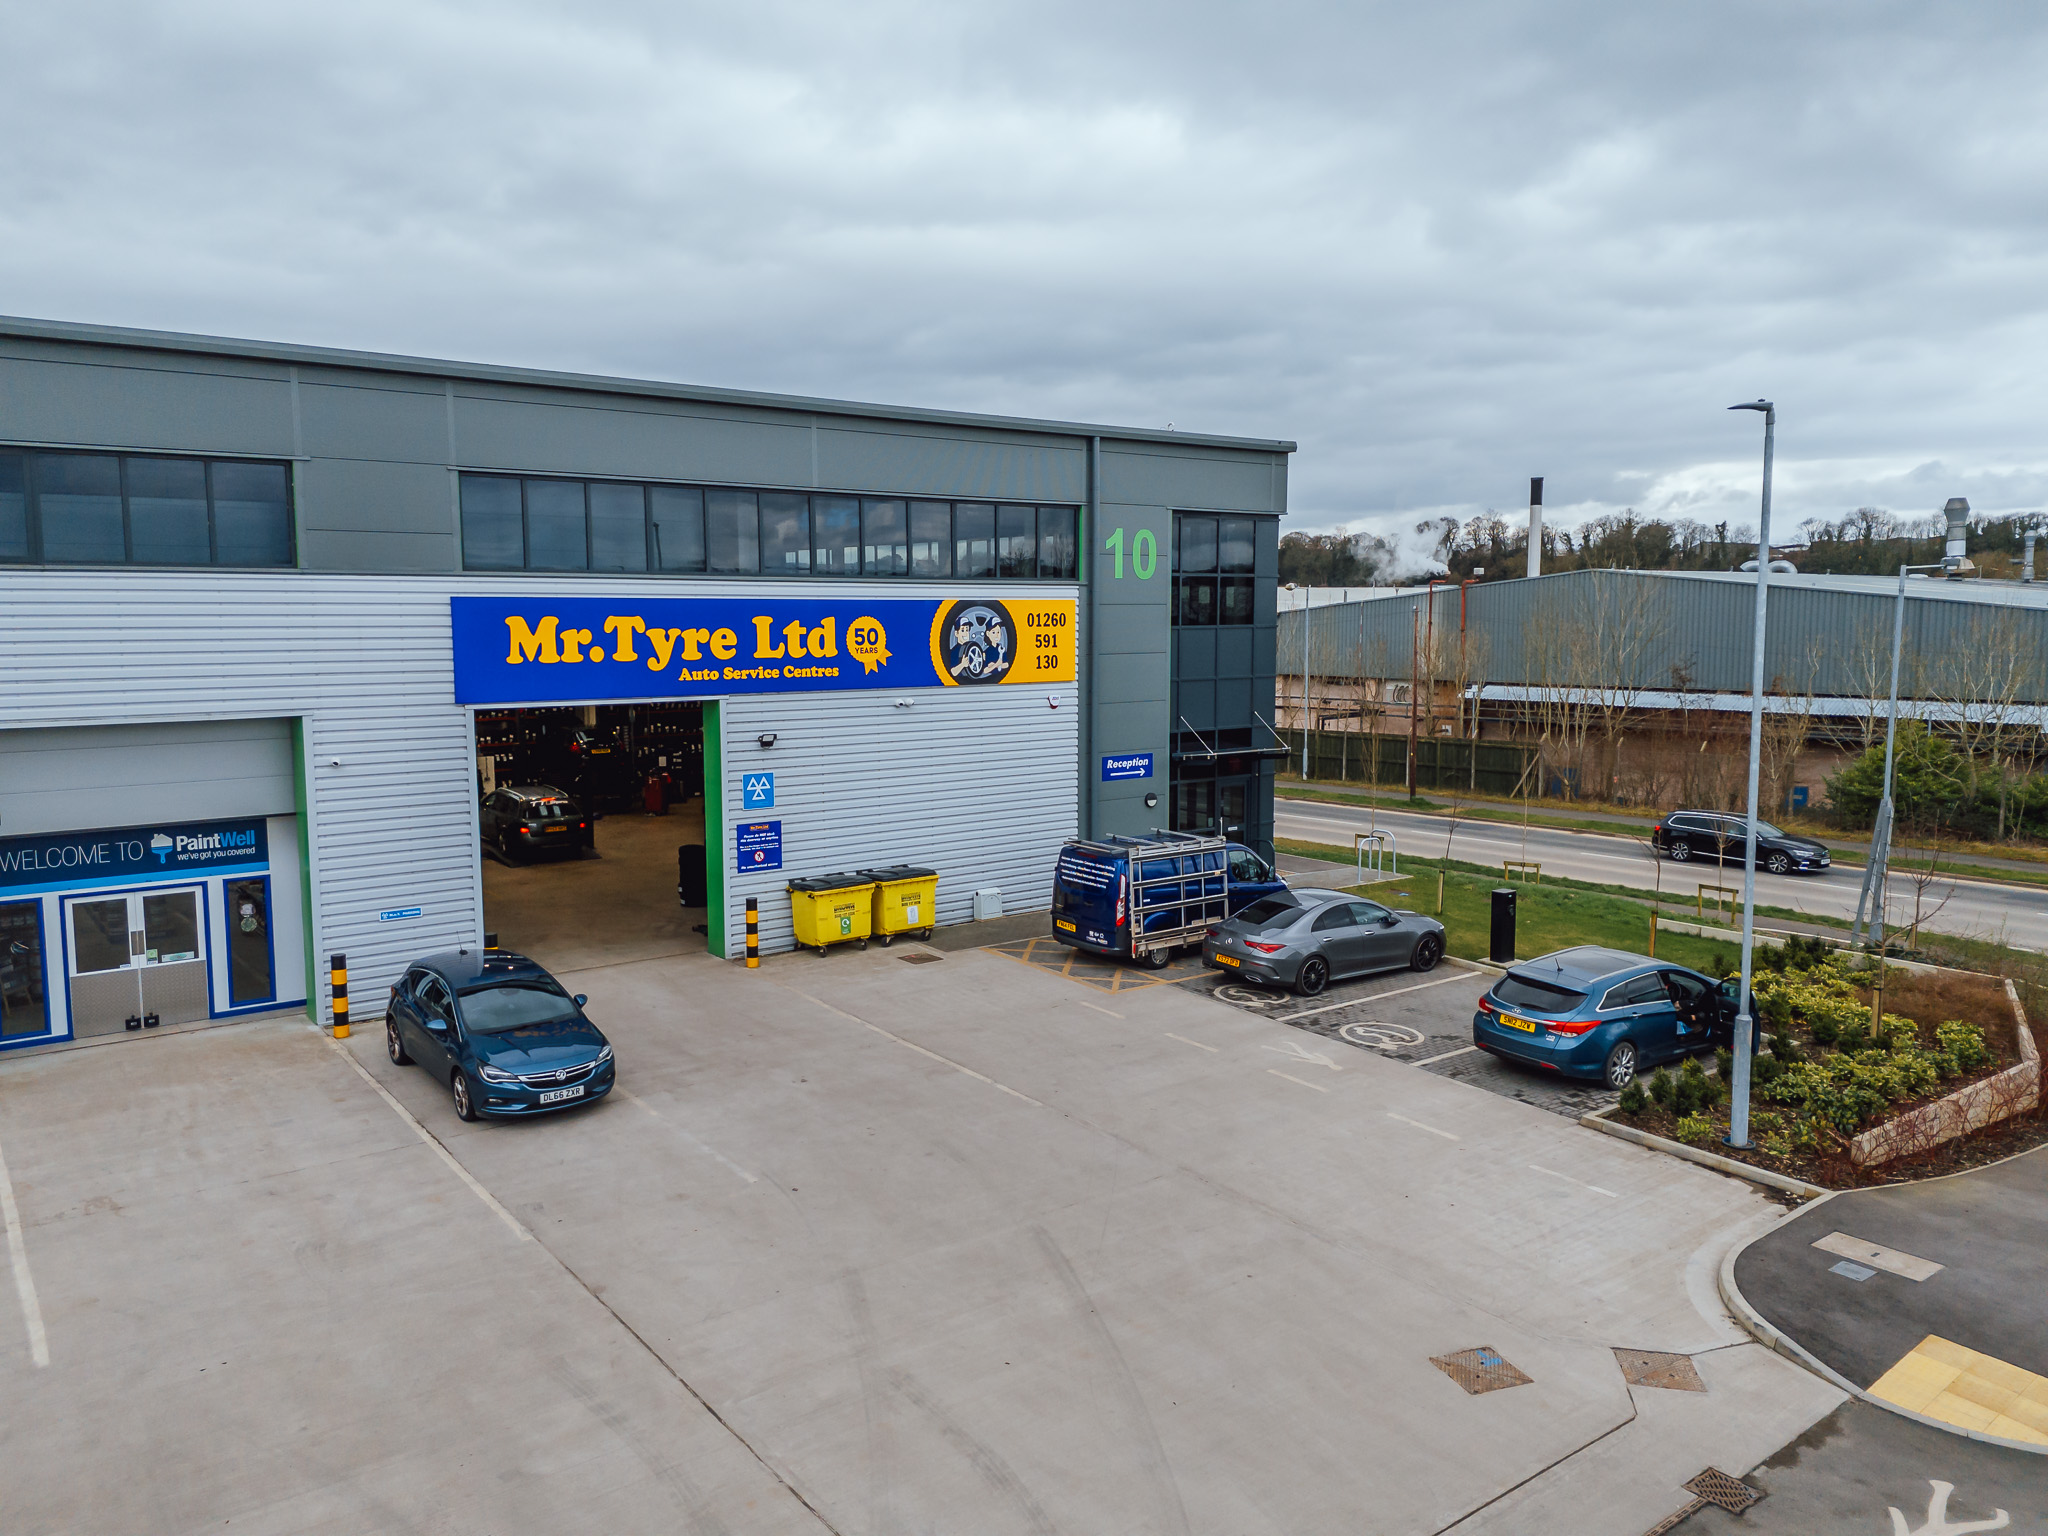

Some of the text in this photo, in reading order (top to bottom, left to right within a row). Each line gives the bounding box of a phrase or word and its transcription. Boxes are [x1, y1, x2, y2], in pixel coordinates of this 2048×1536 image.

[1105, 527, 1157, 580] 10
[1027, 612, 1066, 628] 01260
[751, 615, 839, 659] Ltd
[854, 627, 879, 646] 50
[1035, 633, 1058, 648] 591
[854, 647, 879, 655] YEARS
[1036, 654, 1058, 669] 130
[678, 665, 840, 682] Auto Service Centres
[1106, 756, 1149, 770] Reception
[176, 829, 256, 852] PaintWell
[0, 840, 144, 872] WELCOME TO
[177, 846, 256, 861] we've got you covered
[543, 1087, 581, 1102] DL66 ZXR
